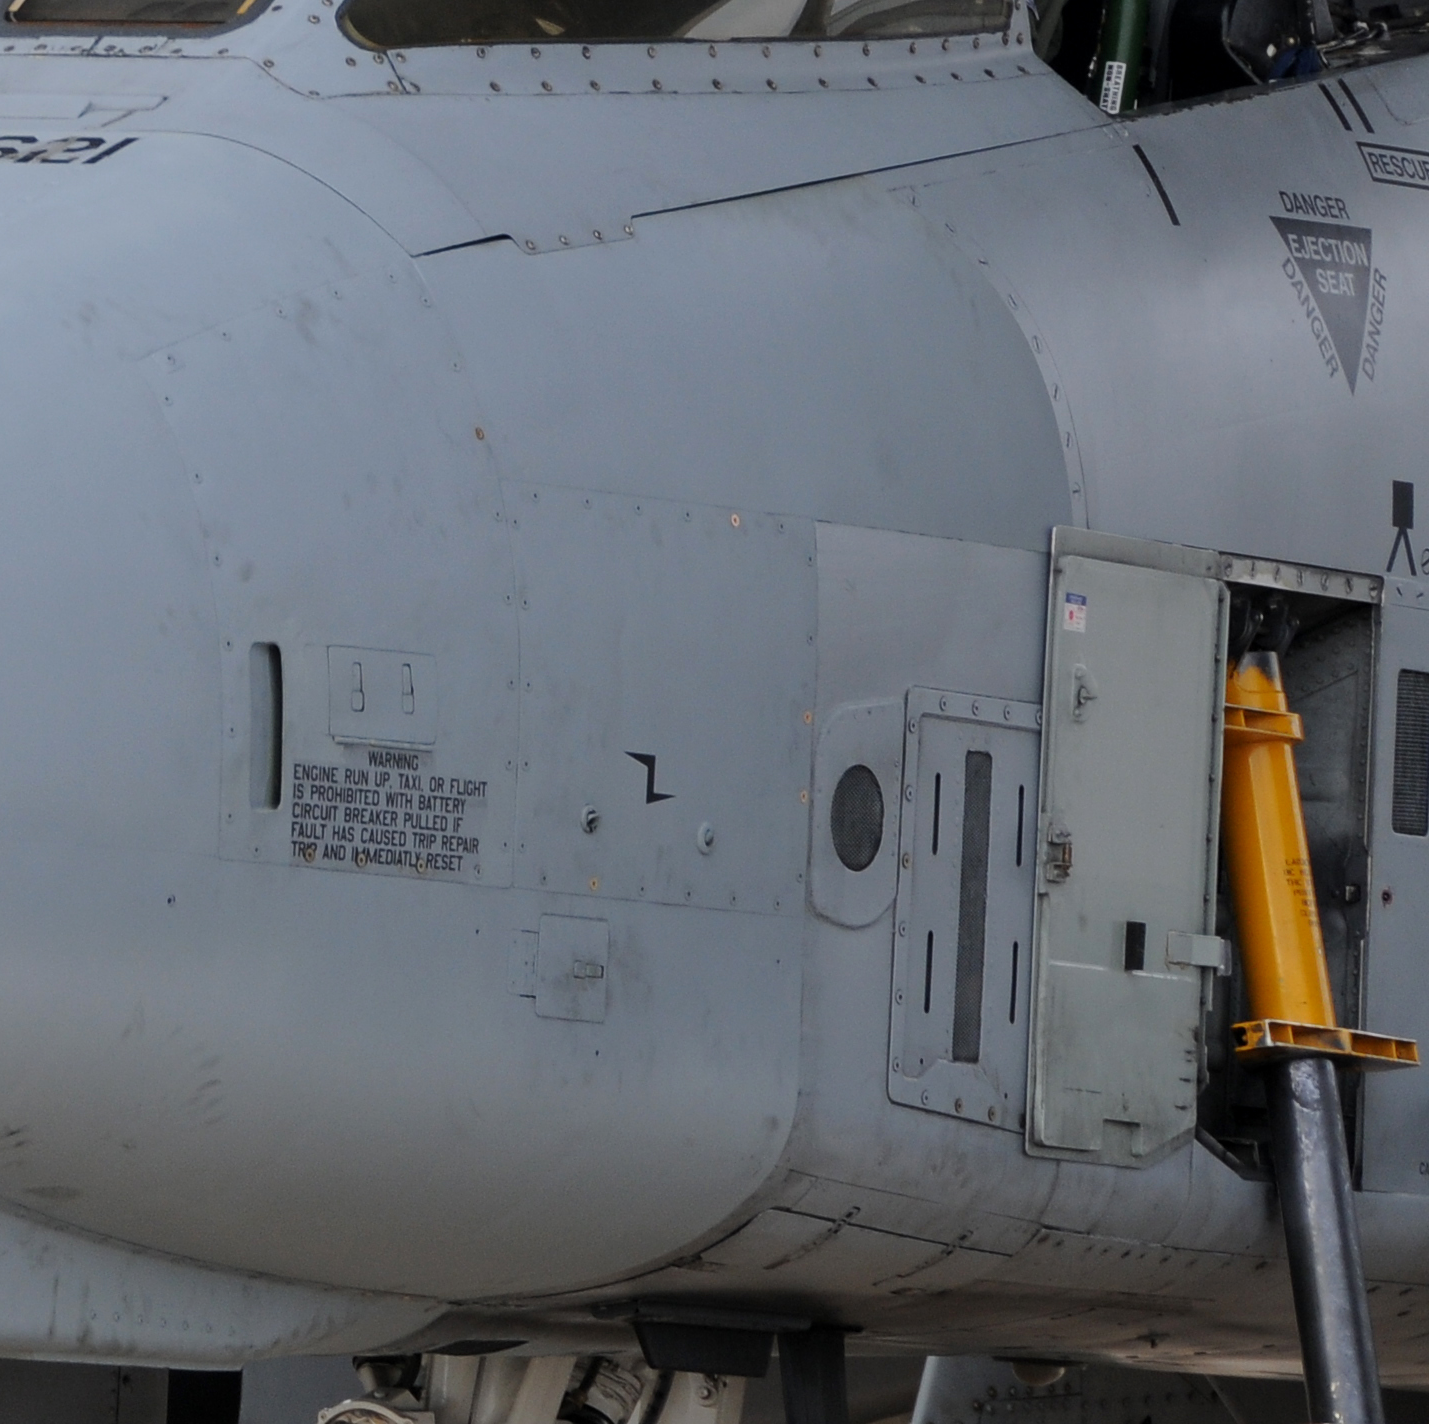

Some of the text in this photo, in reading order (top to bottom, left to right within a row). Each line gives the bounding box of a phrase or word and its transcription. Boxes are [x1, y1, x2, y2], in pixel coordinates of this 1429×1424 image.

[1279, 190, 1350, 220] DANGER
[1287, 233, 1368, 267] EJECTION
[1316, 267, 1356, 297] SEAT
[1281, 257, 1339, 378] DANGER
[1362, 267, 1388, 382] DANGER
[368, 750, 419, 771] WARNING
[293, 763, 338, 784] ENGINE
[344, 768, 369, 786] RUN
[429, 776, 445, 793] OR
[450, 778, 488, 797] FLIGHT
[293, 783, 466, 815] IS PROHIBITED WITH BATTERY
[292, 802, 463, 833] CIRCUIT BREAKER PULLED IF
[291, 821, 479, 854] FAULT HAS CAUSED TRIP REPAIR
[322, 843, 346, 861] AND
[425, 852, 463, 872] RESET
